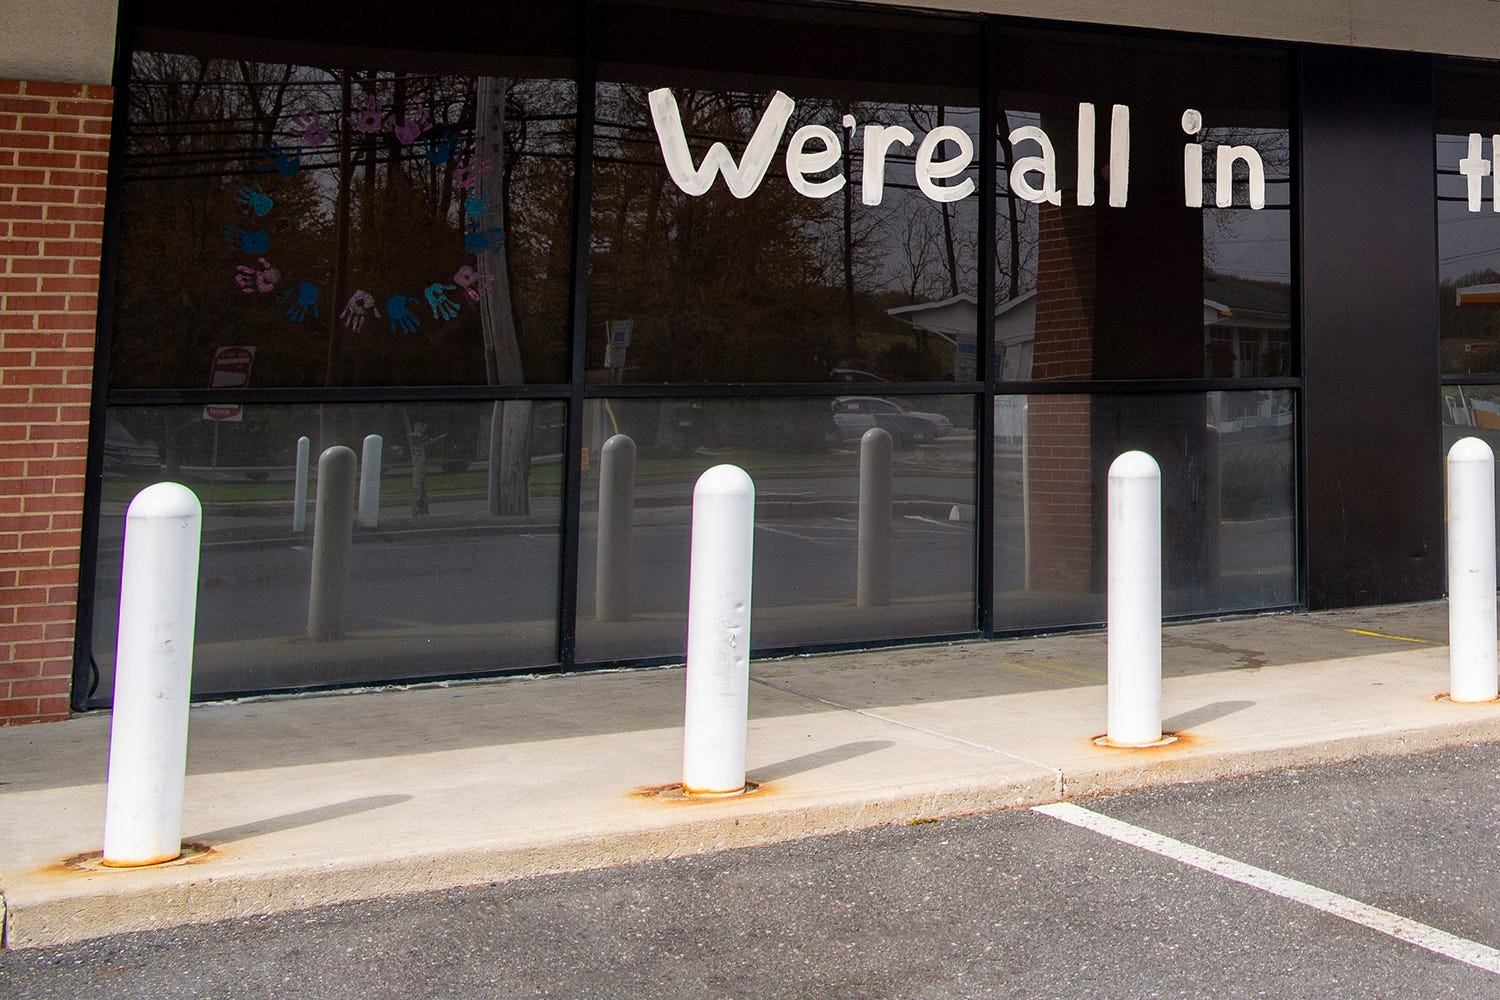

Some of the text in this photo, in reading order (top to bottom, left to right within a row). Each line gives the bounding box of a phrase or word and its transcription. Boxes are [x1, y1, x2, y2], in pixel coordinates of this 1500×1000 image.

[648, 87, 976, 206] We're
[1008, 102, 1130, 208] all
[1181, 108, 1266, 209] in
